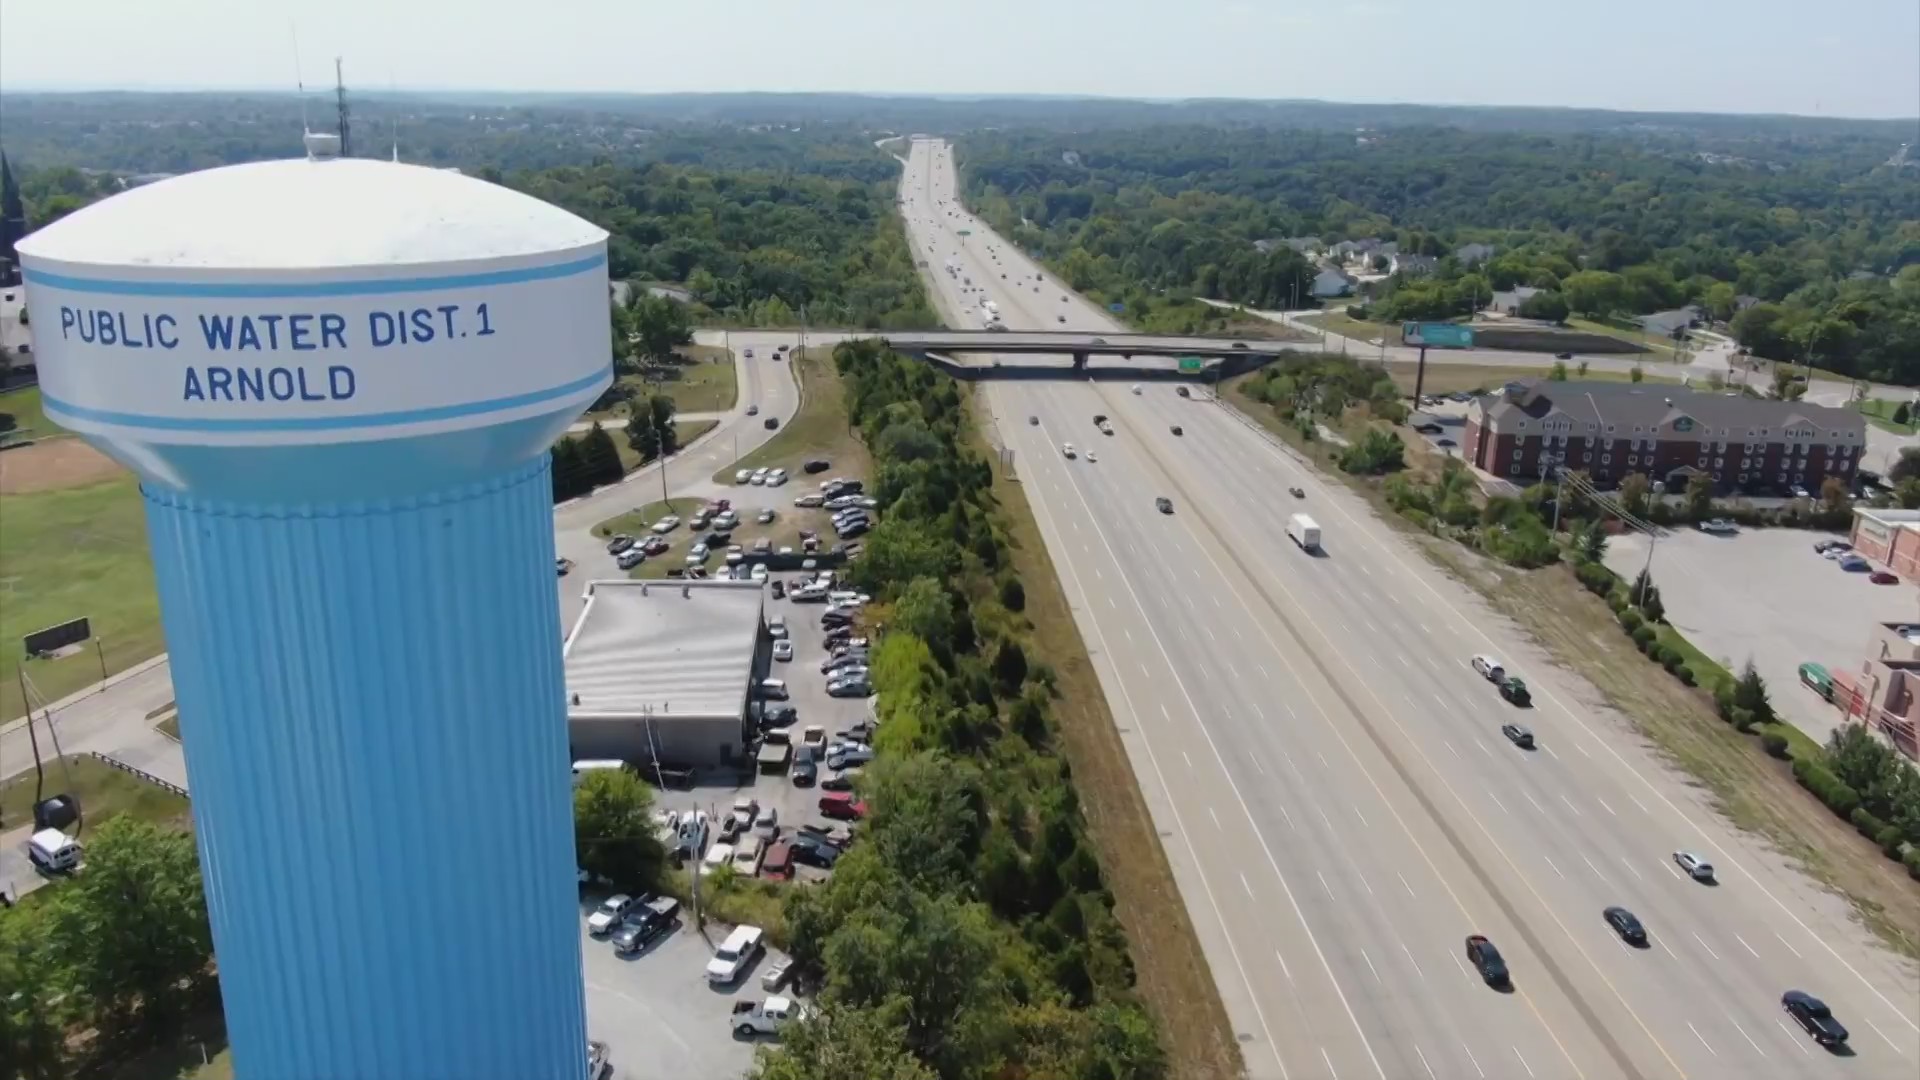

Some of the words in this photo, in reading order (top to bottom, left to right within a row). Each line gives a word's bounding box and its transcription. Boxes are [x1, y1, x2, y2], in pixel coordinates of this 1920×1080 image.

[60, 305, 180, 350] PUBLIC
[197, 312, 348, 352] WATER
[183, 364, 356, 402] ARNOLD
